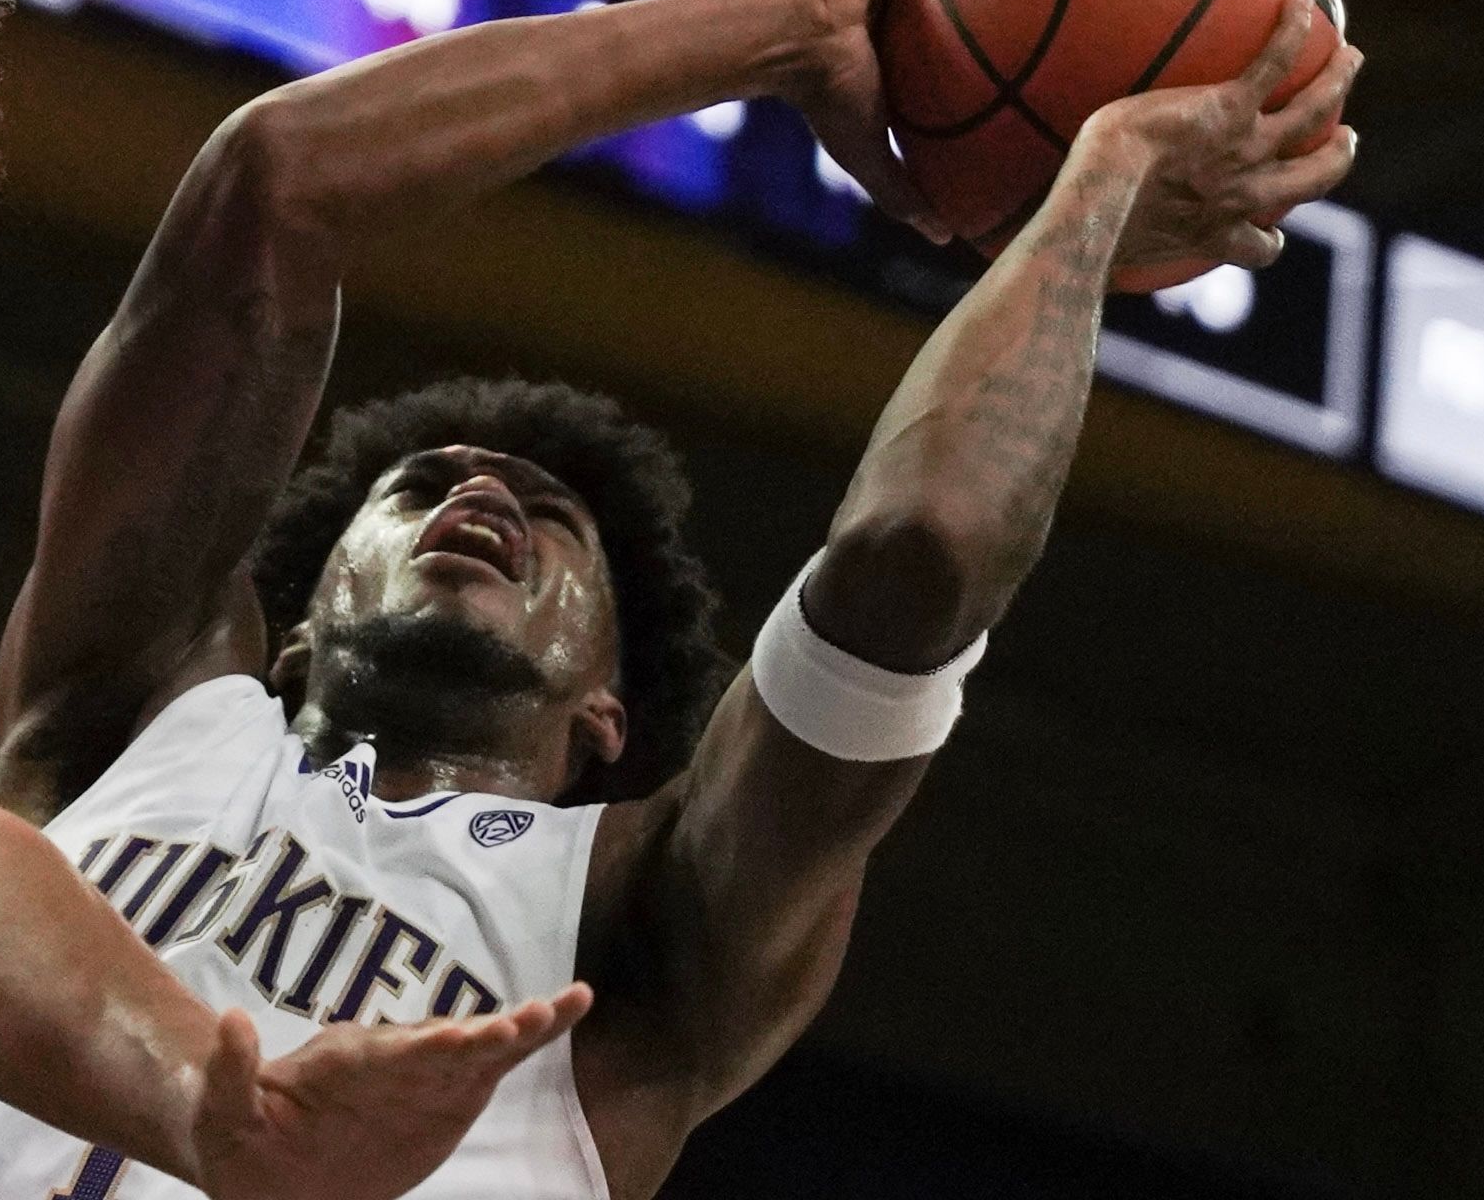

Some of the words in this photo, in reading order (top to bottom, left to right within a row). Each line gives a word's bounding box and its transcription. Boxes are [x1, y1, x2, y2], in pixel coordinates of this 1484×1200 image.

[323, 764, 367, 824] didas
[479, 826, 511, 842] 12
[75, 825, 505, 1026] UKIE
